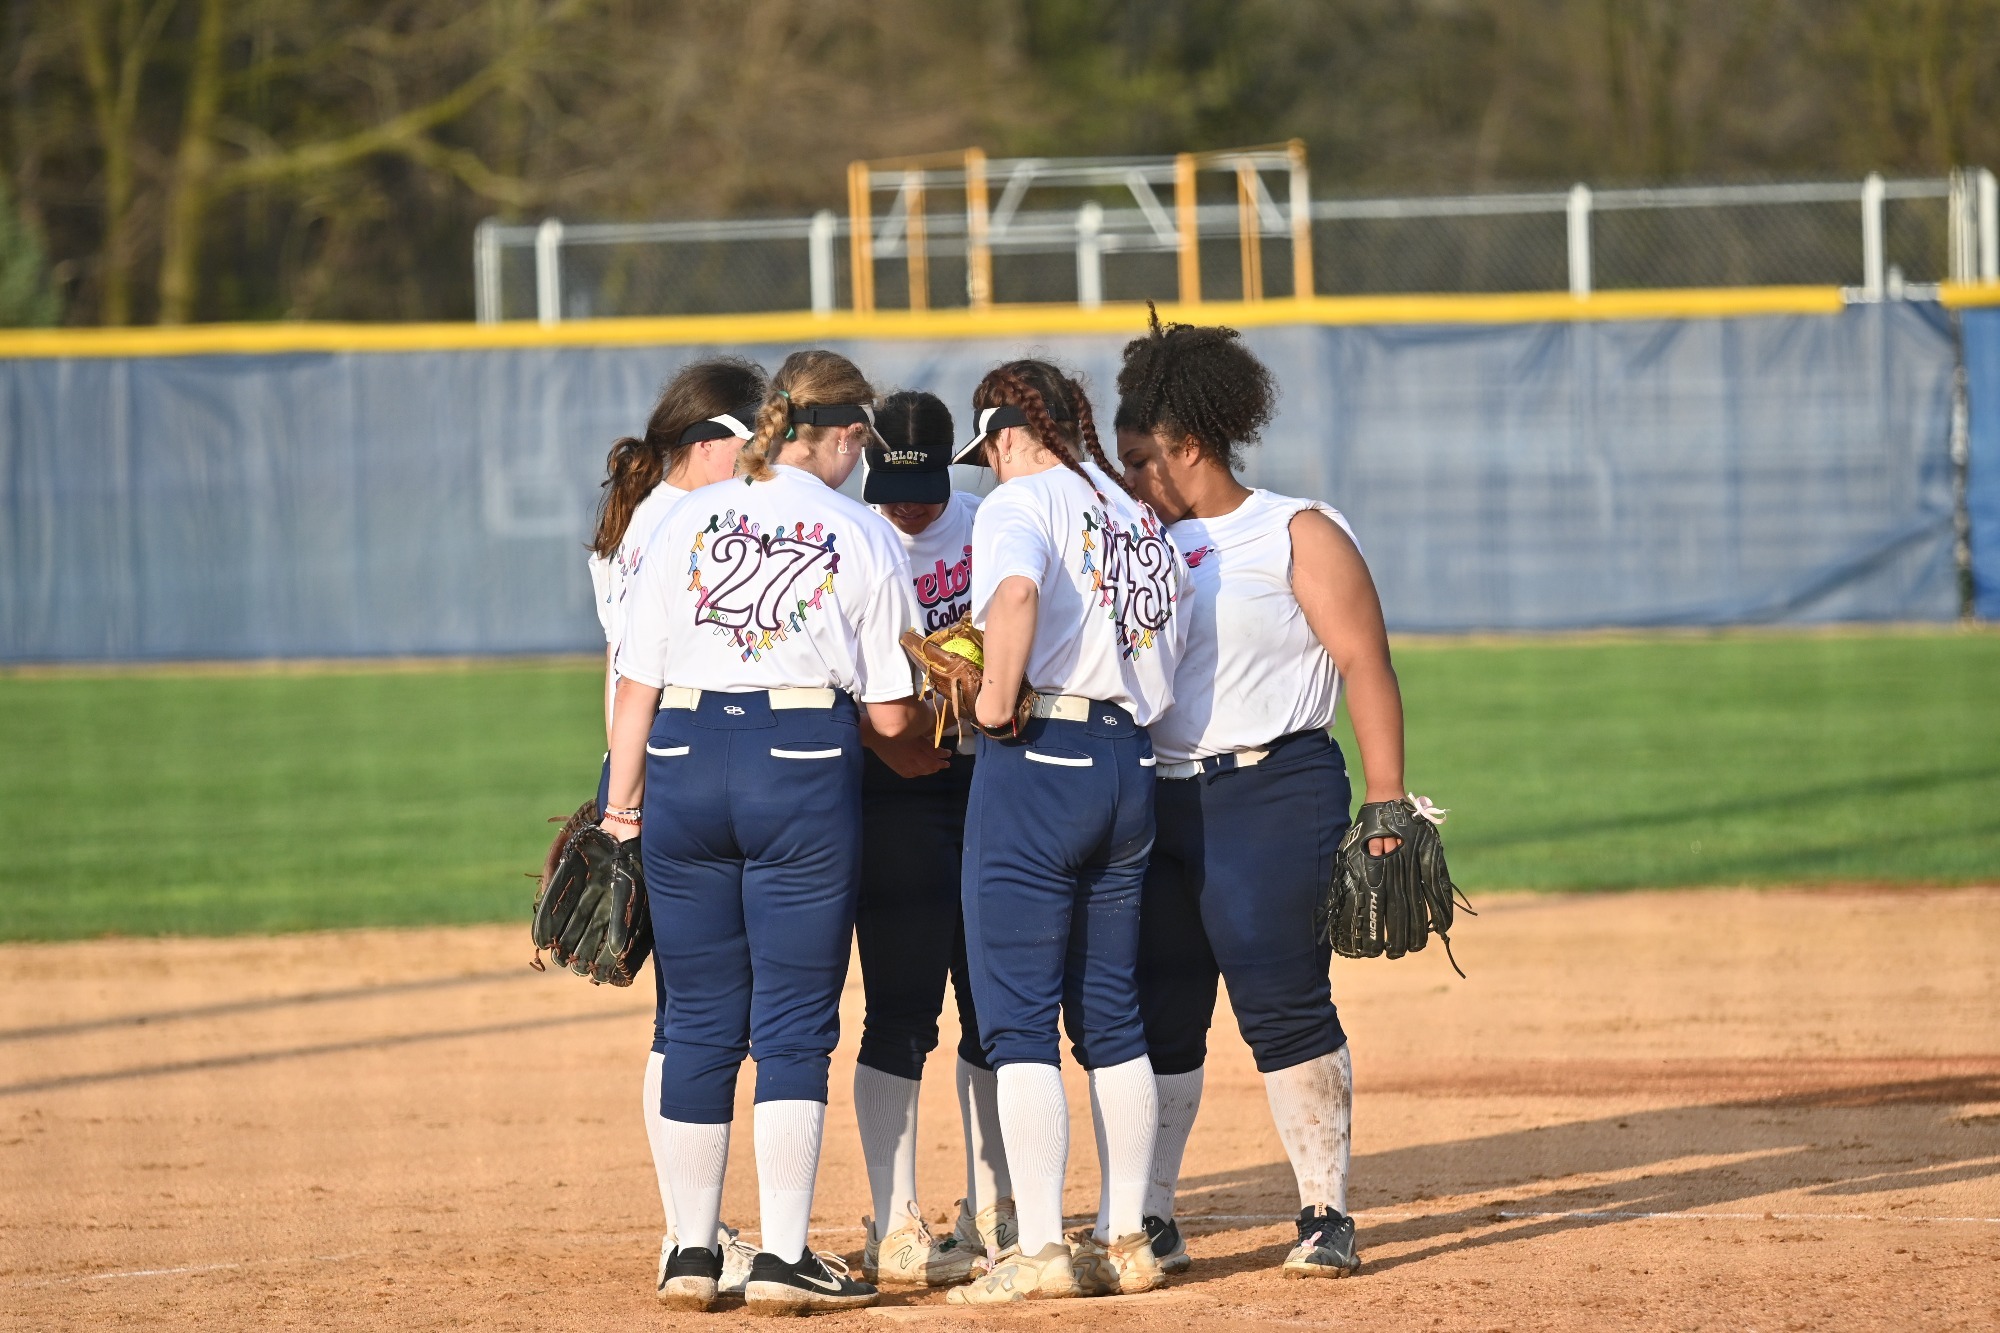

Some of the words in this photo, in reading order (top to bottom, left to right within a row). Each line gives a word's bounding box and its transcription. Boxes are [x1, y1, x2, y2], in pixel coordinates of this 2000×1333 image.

[883, 450, 928, 463] BELOIT
[694, 532, 829, 631] 27
[913, 545, 973, 609] eloi
[1100, 527, 1173, 631] 43
[1368, 891, 1378, 941] WORTH
